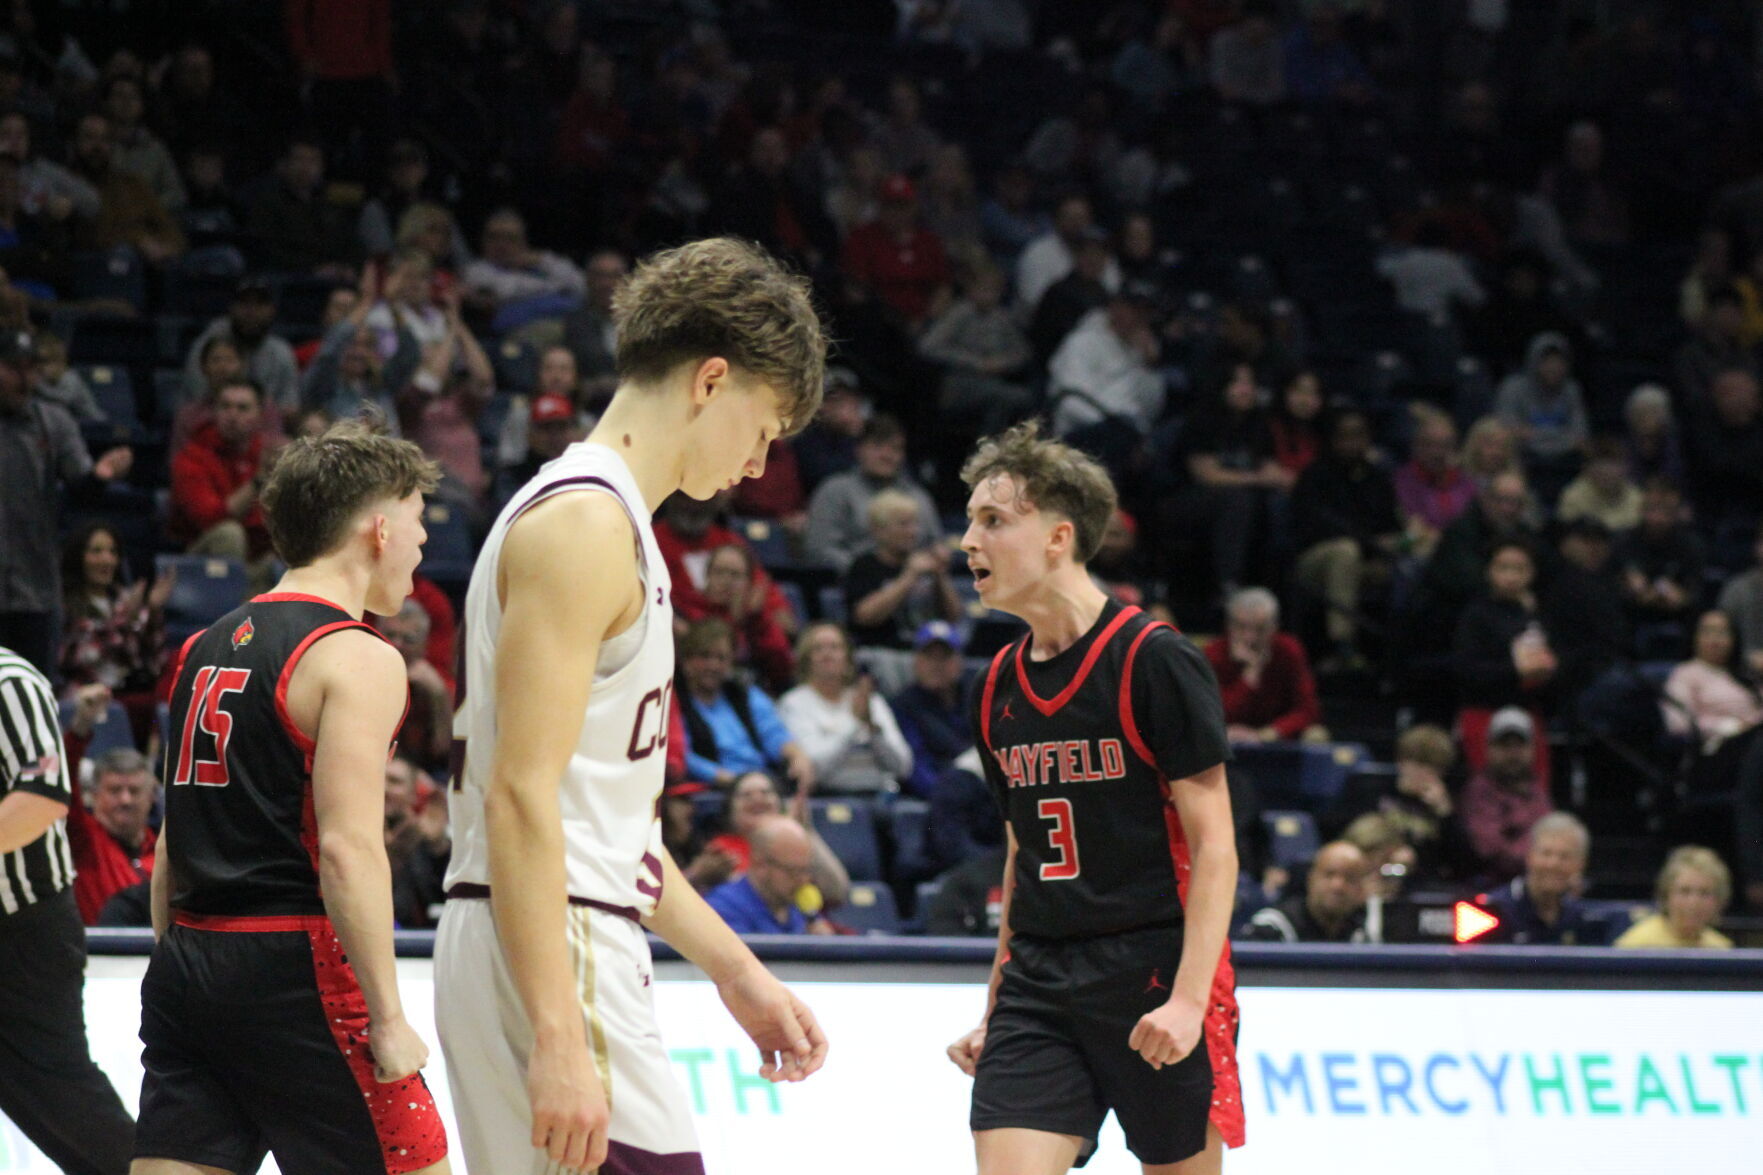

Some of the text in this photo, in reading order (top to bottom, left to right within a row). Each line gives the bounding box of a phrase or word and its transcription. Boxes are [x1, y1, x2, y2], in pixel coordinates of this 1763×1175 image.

[173, 665, 252, 787] 15
[1037, 797, 1081, 881] 3
[1256, 1050, 1763, 1115] MERCYHEALT
